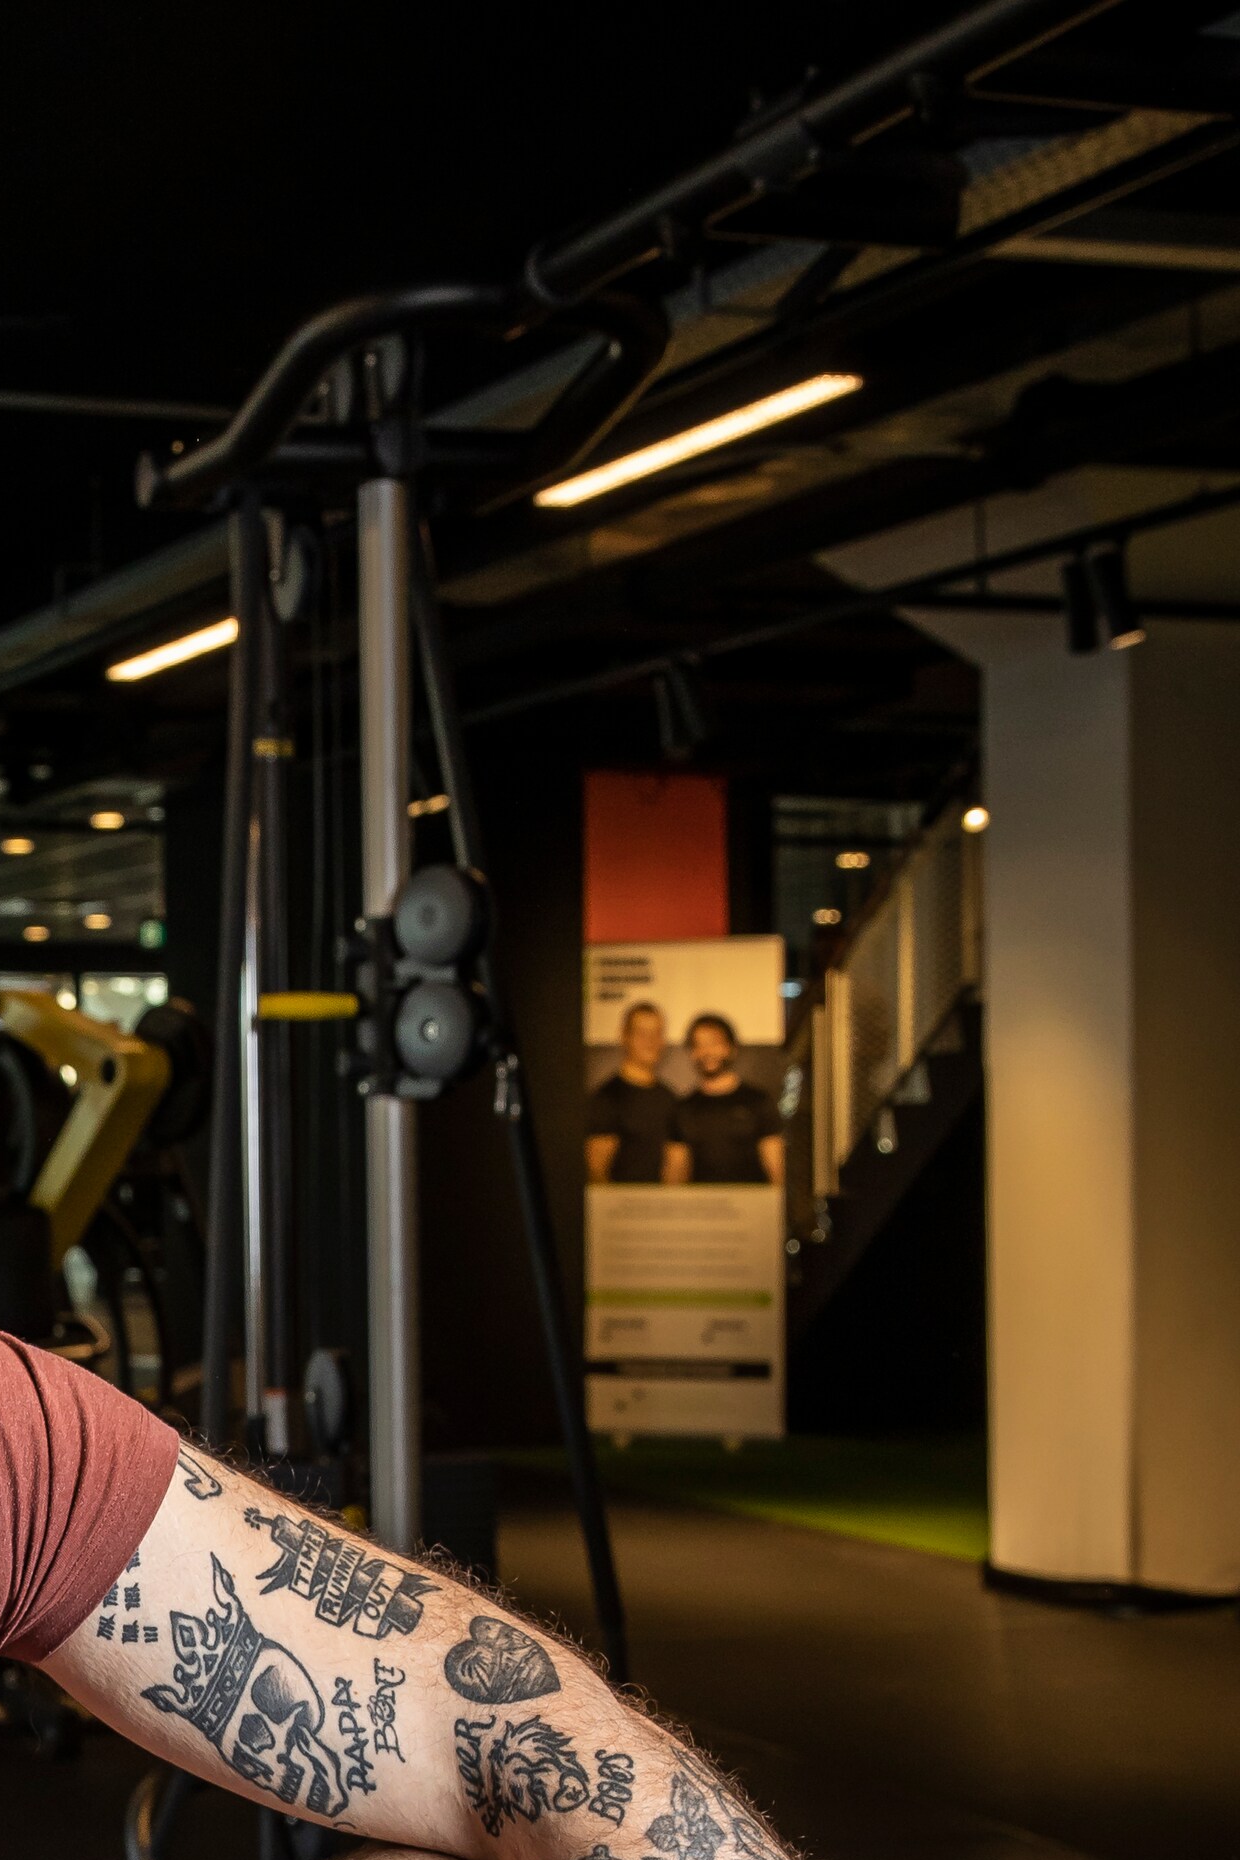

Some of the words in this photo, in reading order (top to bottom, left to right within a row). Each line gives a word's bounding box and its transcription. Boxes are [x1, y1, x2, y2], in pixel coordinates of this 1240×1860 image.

[322, 1545, 360, 1616] RUNNIN
[363, 1578, 393, 1620] OUT
[331, 1677, 377, 1796] PAPA
